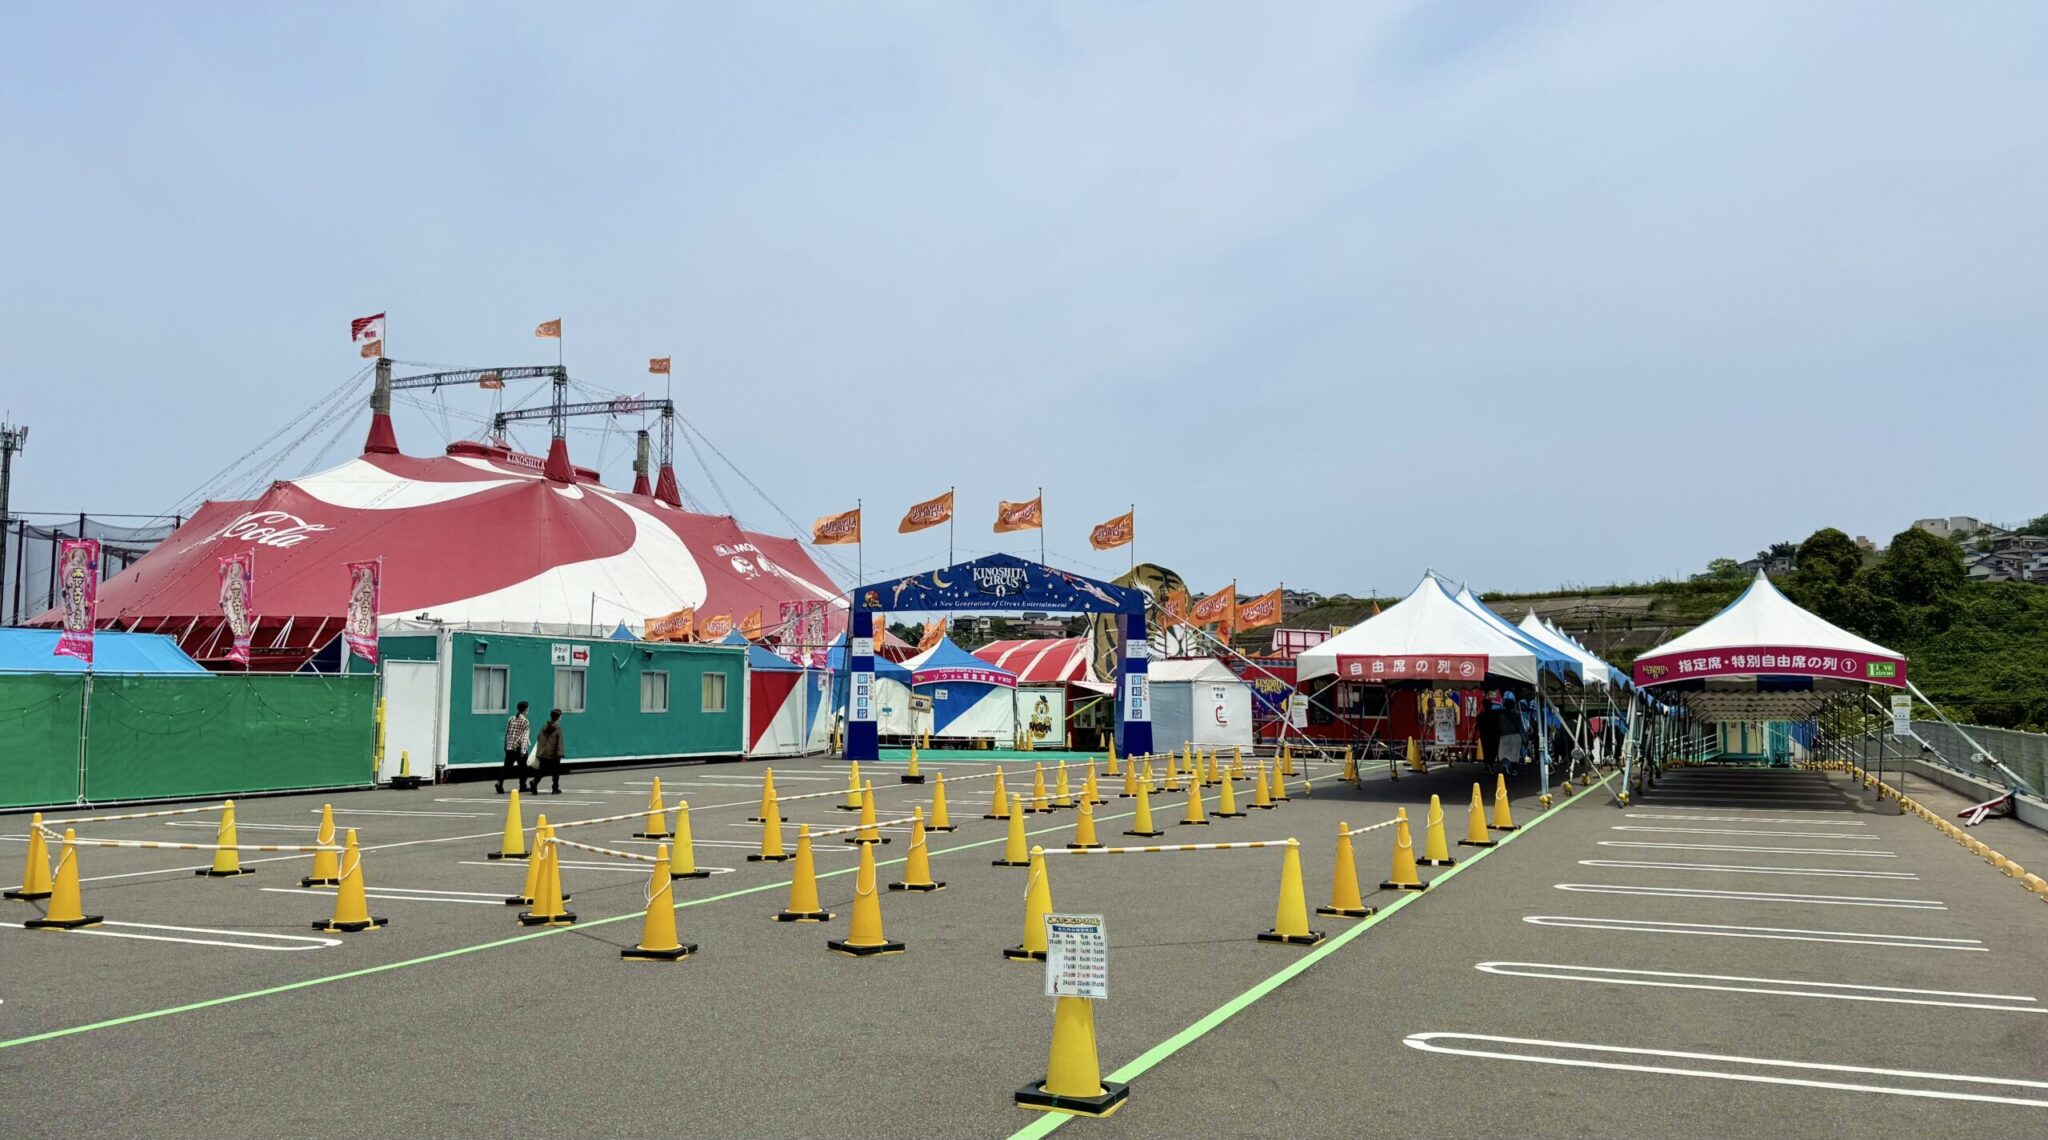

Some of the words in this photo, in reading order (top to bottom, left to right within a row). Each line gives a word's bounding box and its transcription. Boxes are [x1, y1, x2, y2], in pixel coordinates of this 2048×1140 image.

[973, 567, 1029, 582] KINOSHITA
[983, 575, 1019, 588] CIRCUS
[991, 600, 999, 608] of
[1350, 659, 1475, 677] 自由席の列②
[1678, 654, 1857, 674] 指定席・特別自由席の列①
